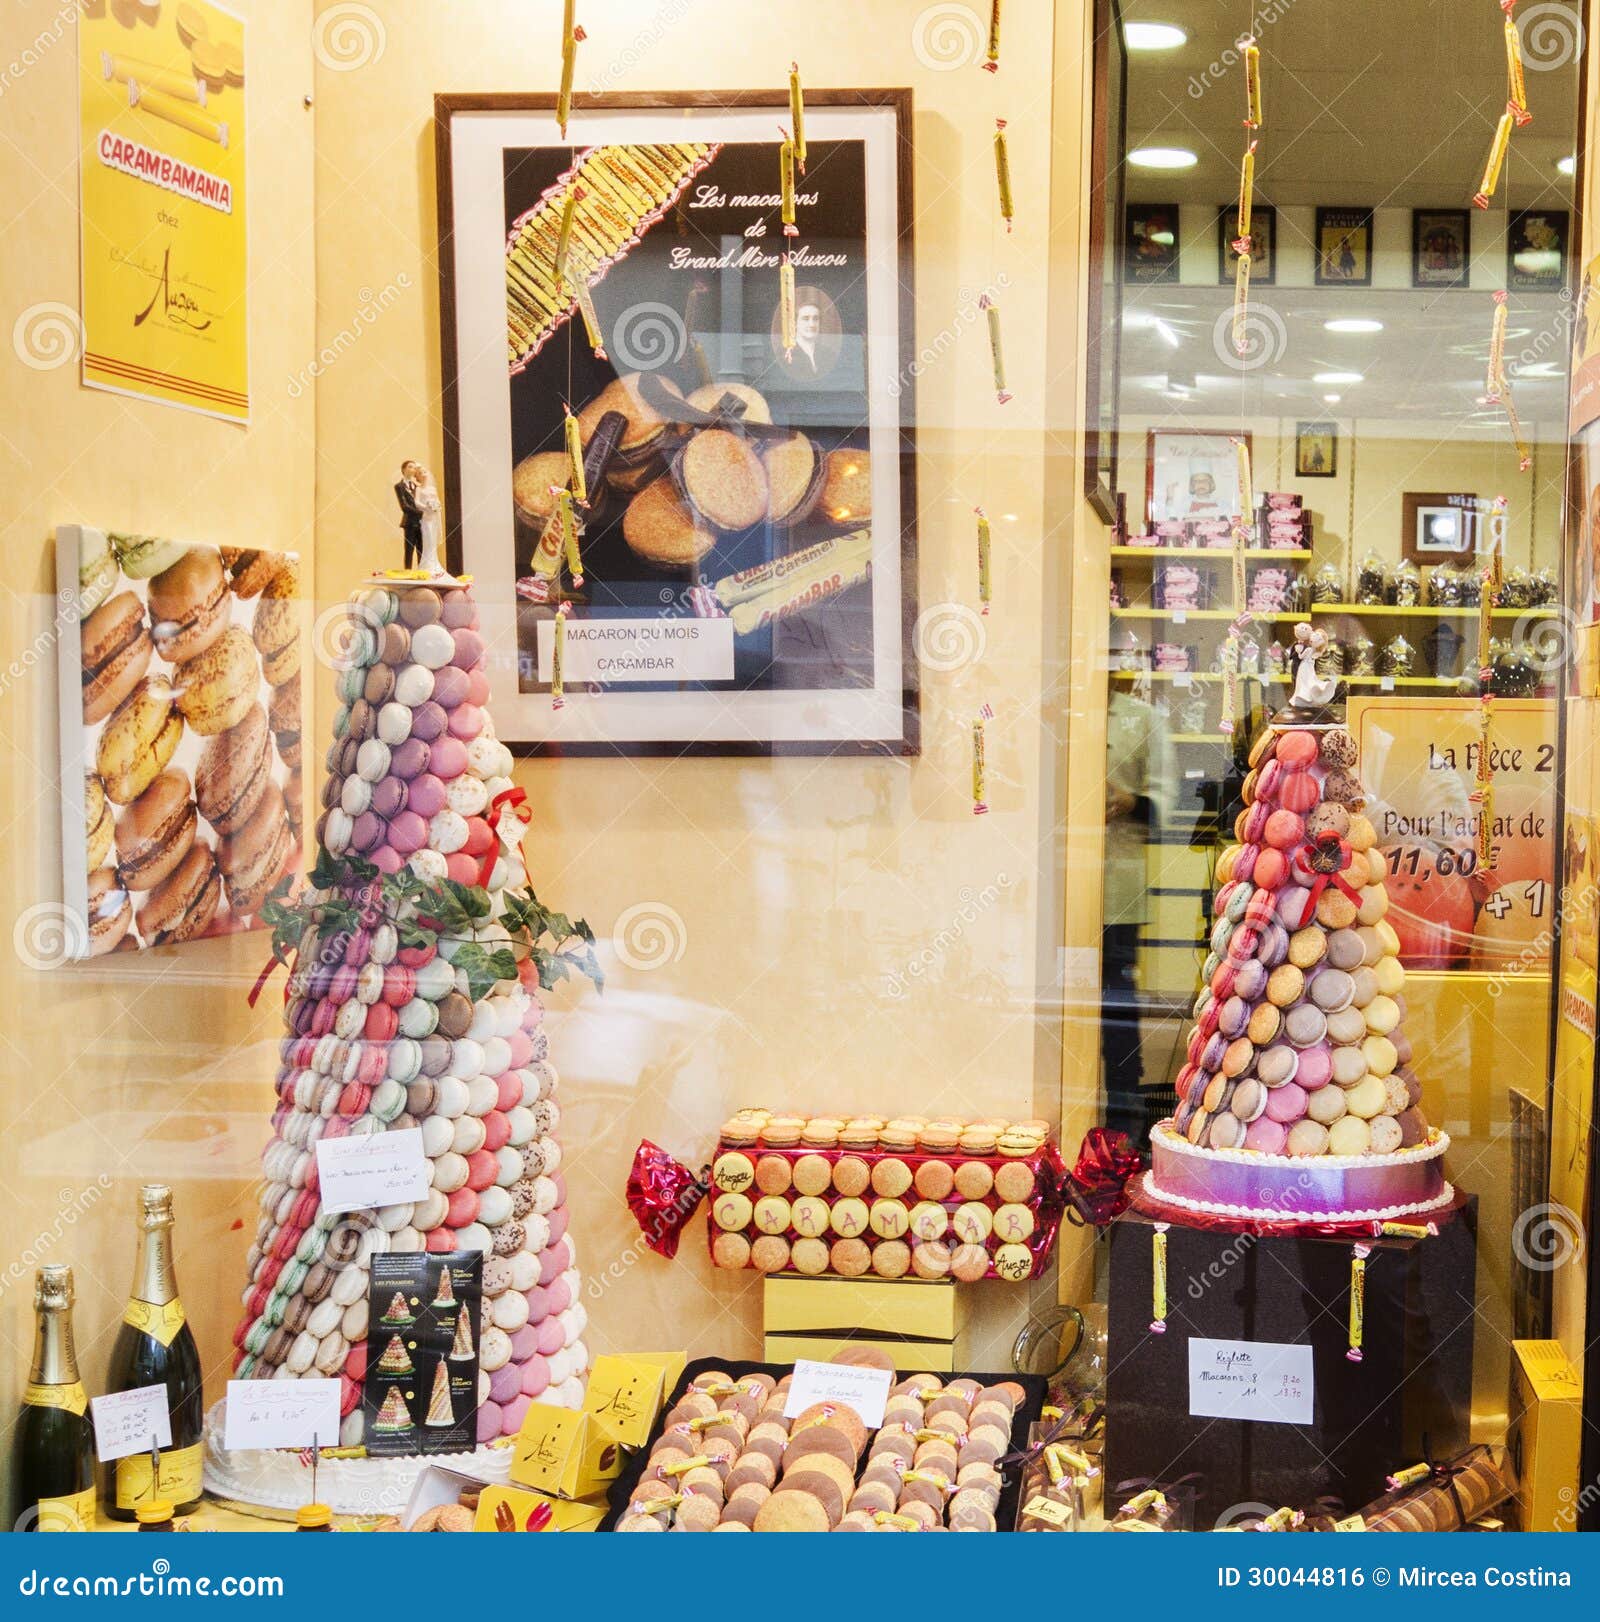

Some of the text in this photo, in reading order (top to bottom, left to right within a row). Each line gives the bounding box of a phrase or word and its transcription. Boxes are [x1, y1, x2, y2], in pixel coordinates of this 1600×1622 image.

[100, 132, 230, 207] CARAMBAMANIA
[688, 185, 726, 209] Les
[156, 208, 179, 229] chez
[744, 217, 767, 238] de
[668, 247, 730, 271] Grand
[733, 246, 780, 269] Mère
[567, 626, 700, 641] MACARON DU MOIS
[597, 657, 675, 671] CARAMBAR
[1428, 742, 1555, 772] La Pèce 2
[1383, 810, 1435, 836] Pour
[1520, 811, 1545, 838] de
[1524, 878, 1546, 918] 1
[156, 1239, 165, 1292] CHAMPAGNE
[63, 1321, 74, 1373] CHAMPAGNE
